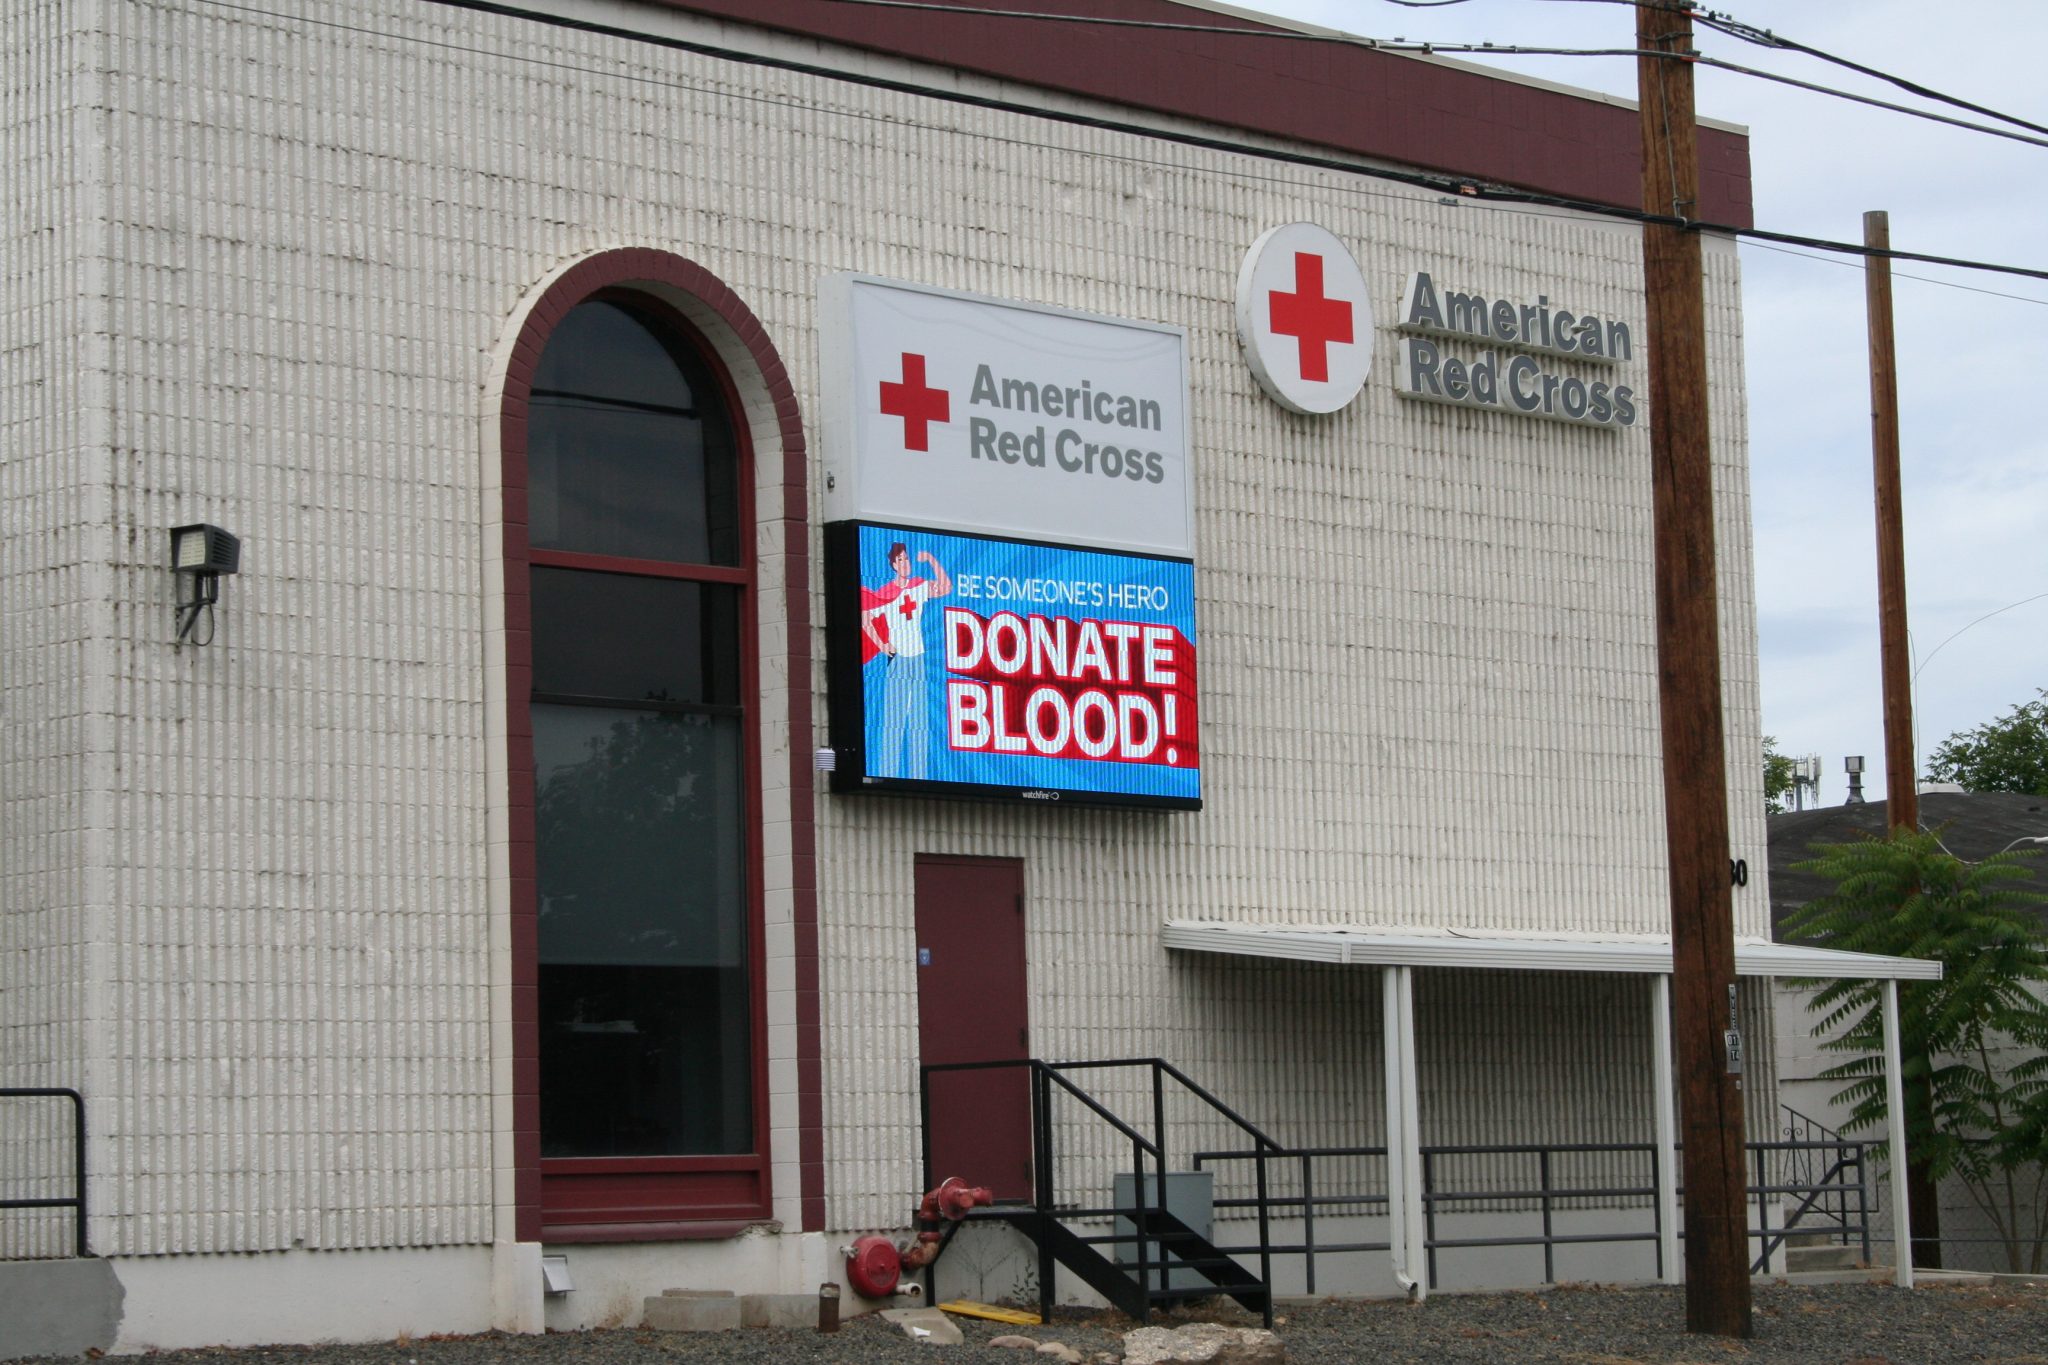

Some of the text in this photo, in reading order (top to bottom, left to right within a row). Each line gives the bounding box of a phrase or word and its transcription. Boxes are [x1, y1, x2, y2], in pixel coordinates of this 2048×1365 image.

[1407, 271, 1633, 362] American
[968, 363, 1162, 432] American
[1408, 338, 1637, 428] Red Cross
[969, 416, 1165, 485] Red Cross
[957, 573, 1169, 611] BE SOMEONE'S HERO
[945, 608, 1177, 686] DONATE
[948, 682, 1178, 765] BLOOD!
